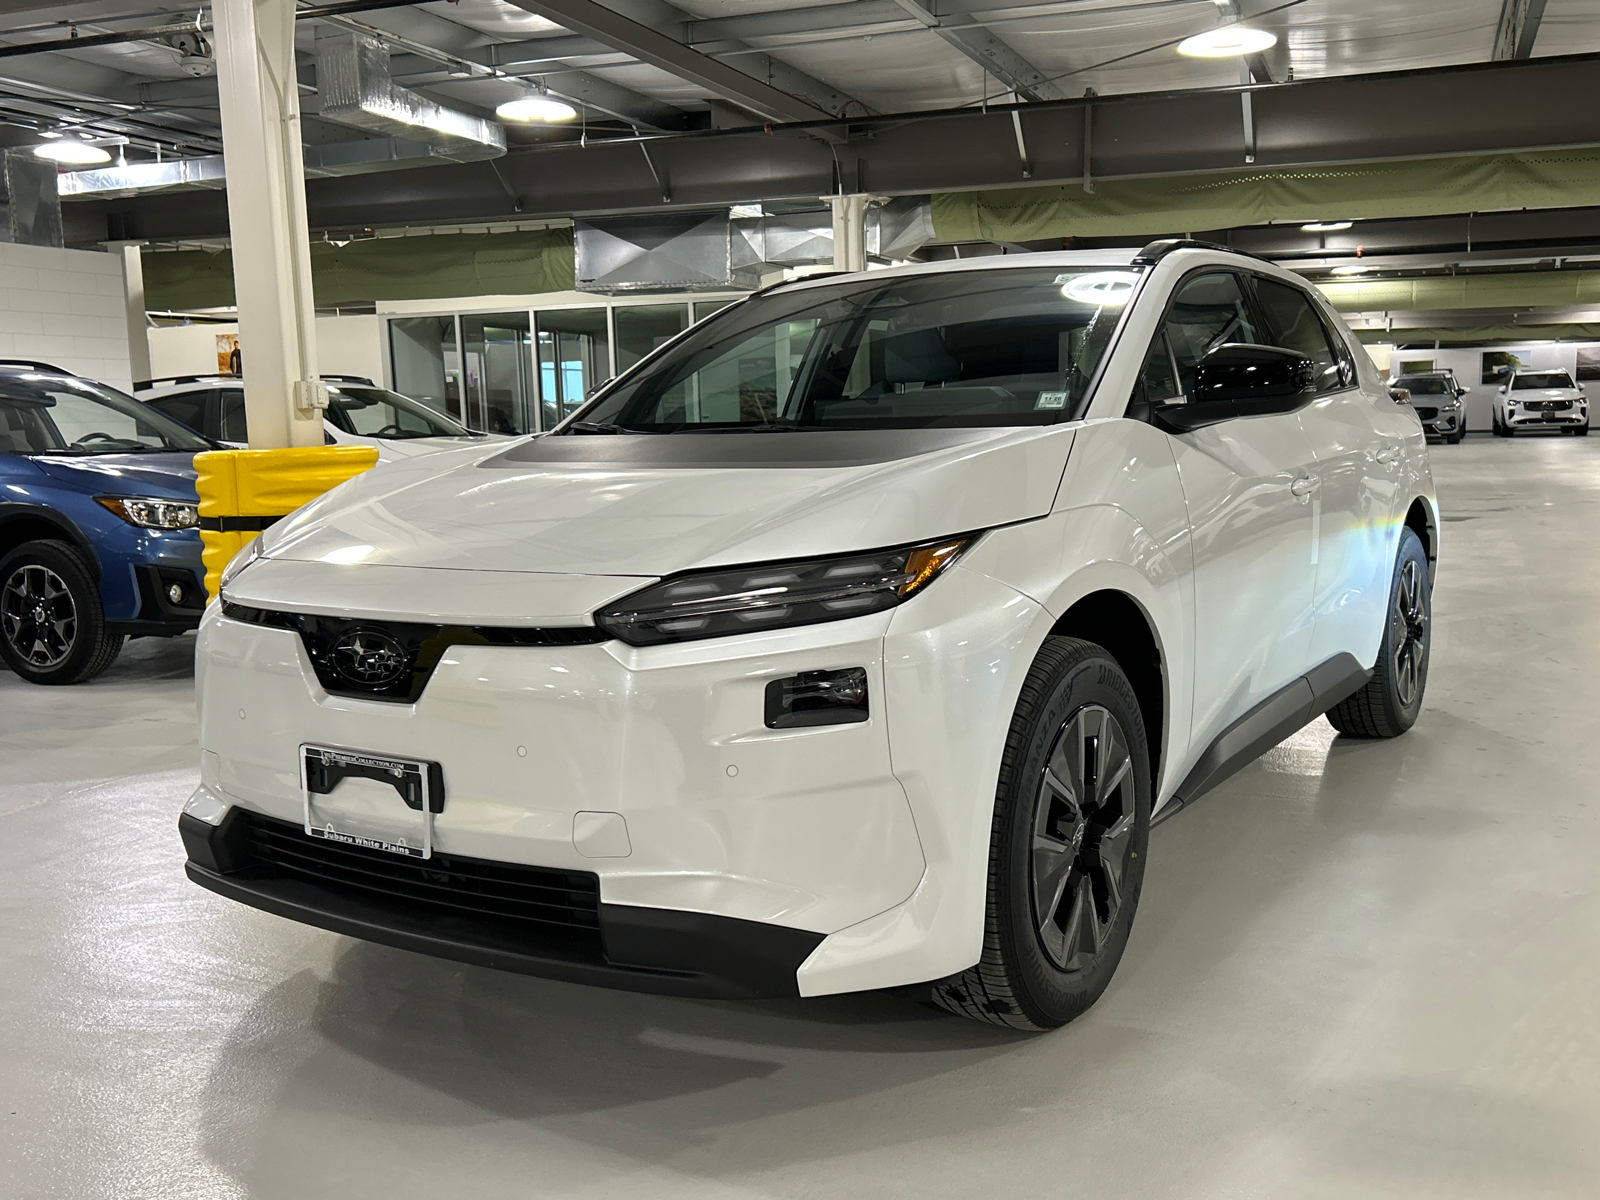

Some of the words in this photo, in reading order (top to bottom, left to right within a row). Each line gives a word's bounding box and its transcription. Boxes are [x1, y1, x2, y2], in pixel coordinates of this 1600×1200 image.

[1096, 664, 1146, 749] BRIDGESTONE
[323, 831, 353, 843] Subaru
[355, 836, 380, 848] White
[382, 842, 410, 854] Plains
